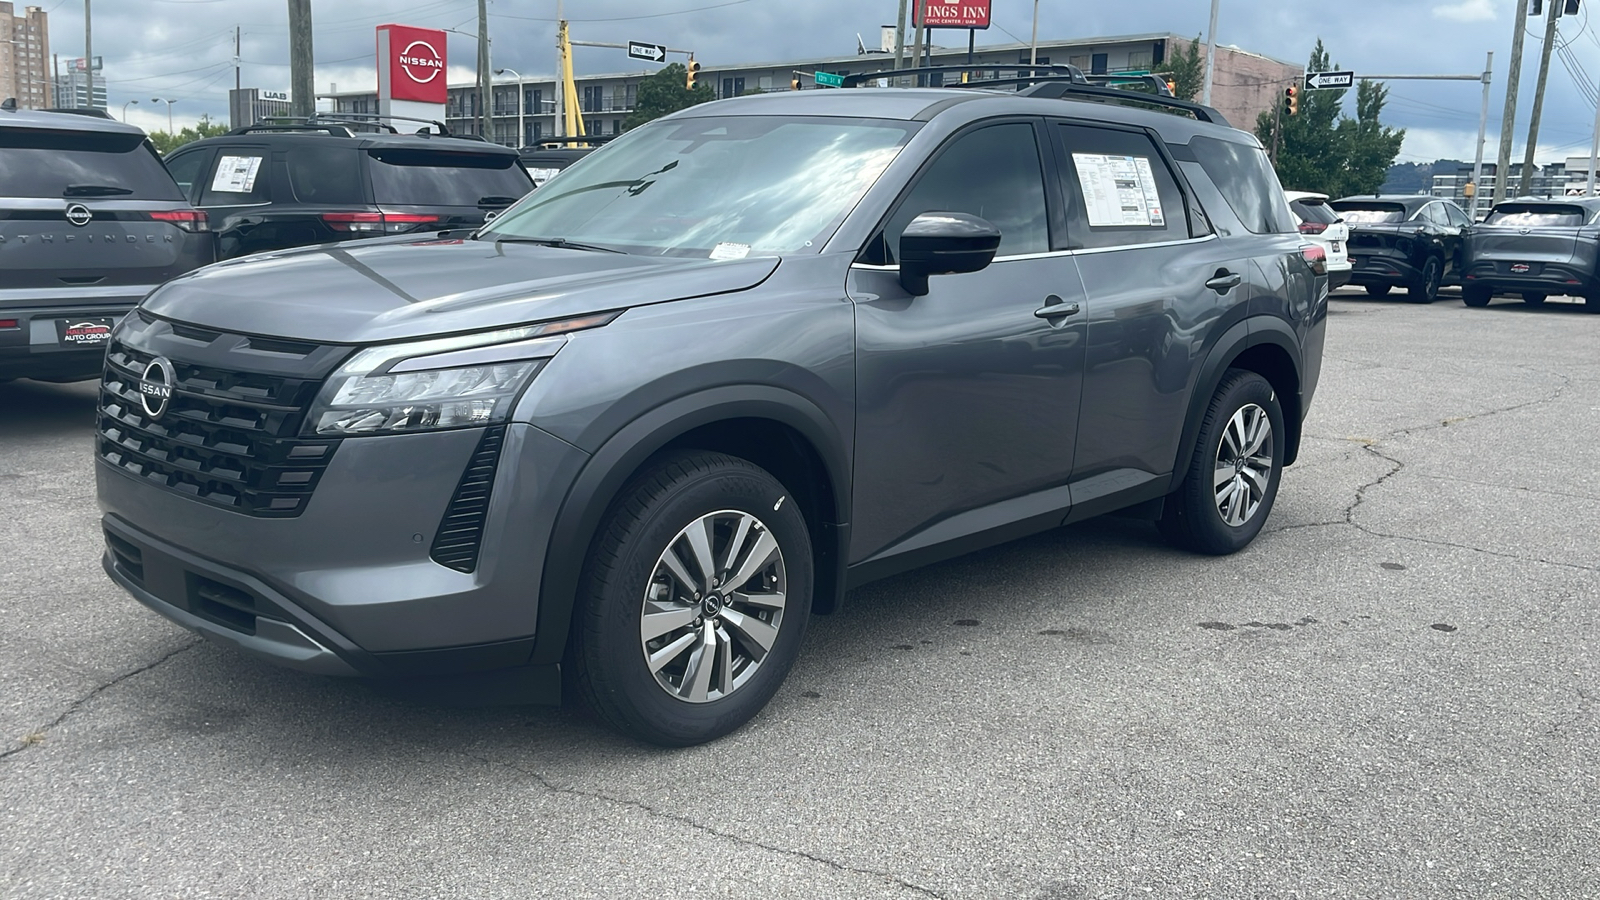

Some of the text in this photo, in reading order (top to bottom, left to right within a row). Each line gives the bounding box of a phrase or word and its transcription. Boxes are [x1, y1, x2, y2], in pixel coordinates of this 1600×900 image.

[921, 5, 987, 19] INGS INN
[633, 46, 643, 54] ONE
[400, 56, 443, 68] NISSAN
[264, 91, 287, 101] UAB
[86, 332, 111, 340] GROUP
[140, 382, 170, 397] ISSAN
